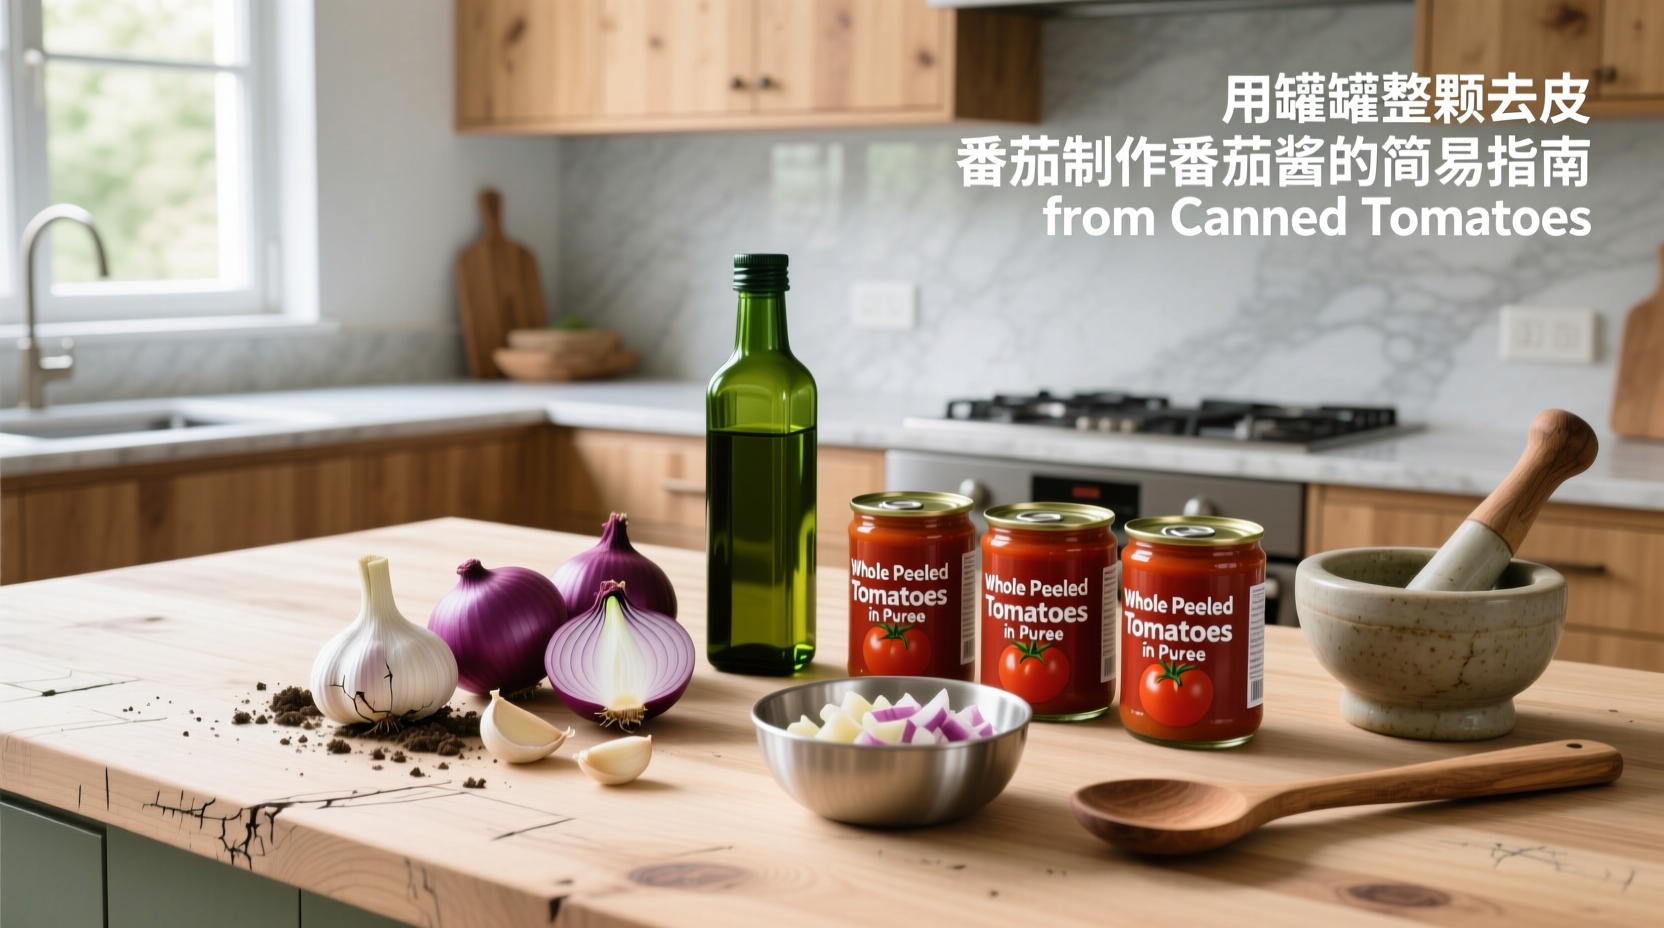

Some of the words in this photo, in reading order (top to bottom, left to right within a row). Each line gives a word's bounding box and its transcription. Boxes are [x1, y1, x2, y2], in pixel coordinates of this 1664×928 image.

[851, 559, 889, 581] Whole
[894, 563, 948, 581] Peeled
[852, 579, 947, 606] Tomatoes
[985, 573, 1026, 597] Whole
[1031, 578, 1087, 597] Peeled
[985, 595, 1087, 624] Tomatoes
[1124, 588, 1167, 615] Whole
[1172, 596, 1233, 615] Peeled
[869, 607, 879, 621] in
[883, 608, 925, 622] Puree
[1124, 610, 1233, 643] Tomatoes
[1004, 623, 1014, 639] in
[1020, 625, 1063, 640] Puree
[1143, 641, 1154, 657] in
[1159, 644, 1205, 661] Puree
